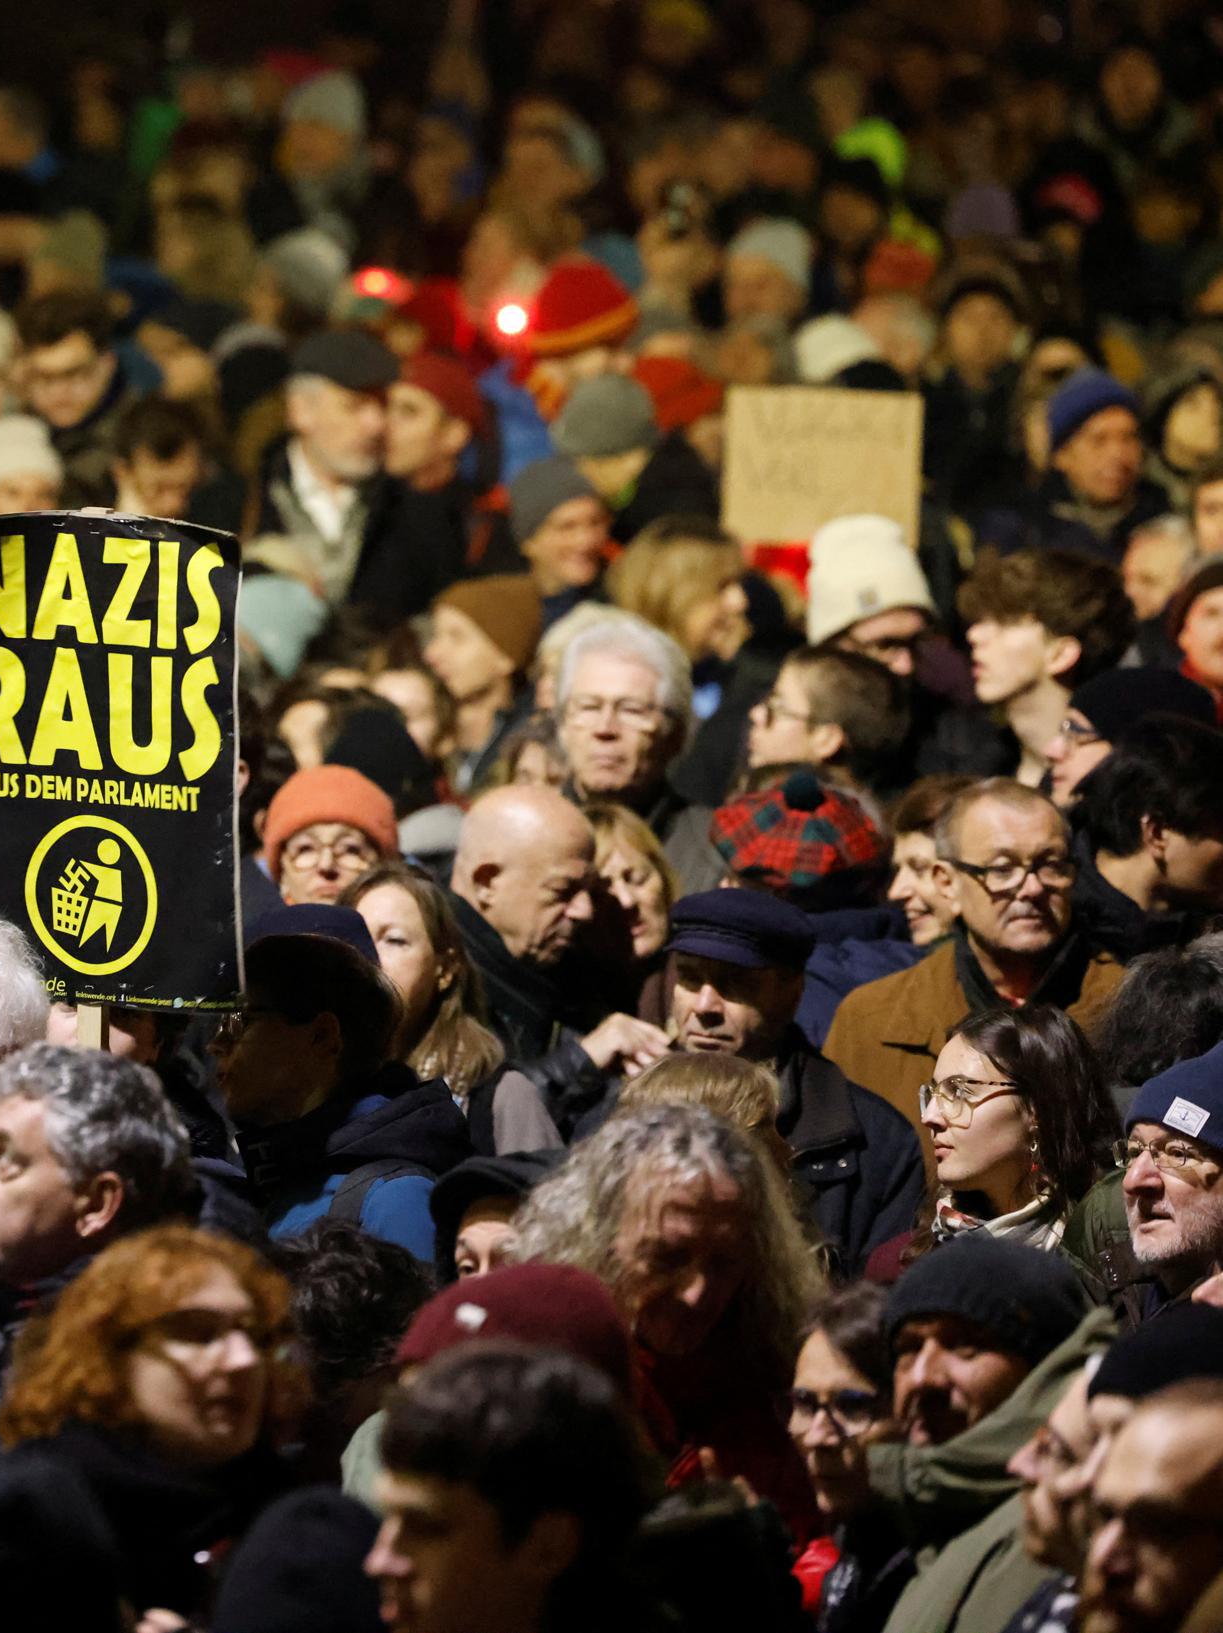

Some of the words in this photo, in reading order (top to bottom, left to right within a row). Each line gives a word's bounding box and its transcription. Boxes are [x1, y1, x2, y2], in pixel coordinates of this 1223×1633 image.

[25, 774, 72, 801] DEM
[76, 778, 200, 812] PARLAMENT
[75, 990, 117, 1003] linkswende.org
